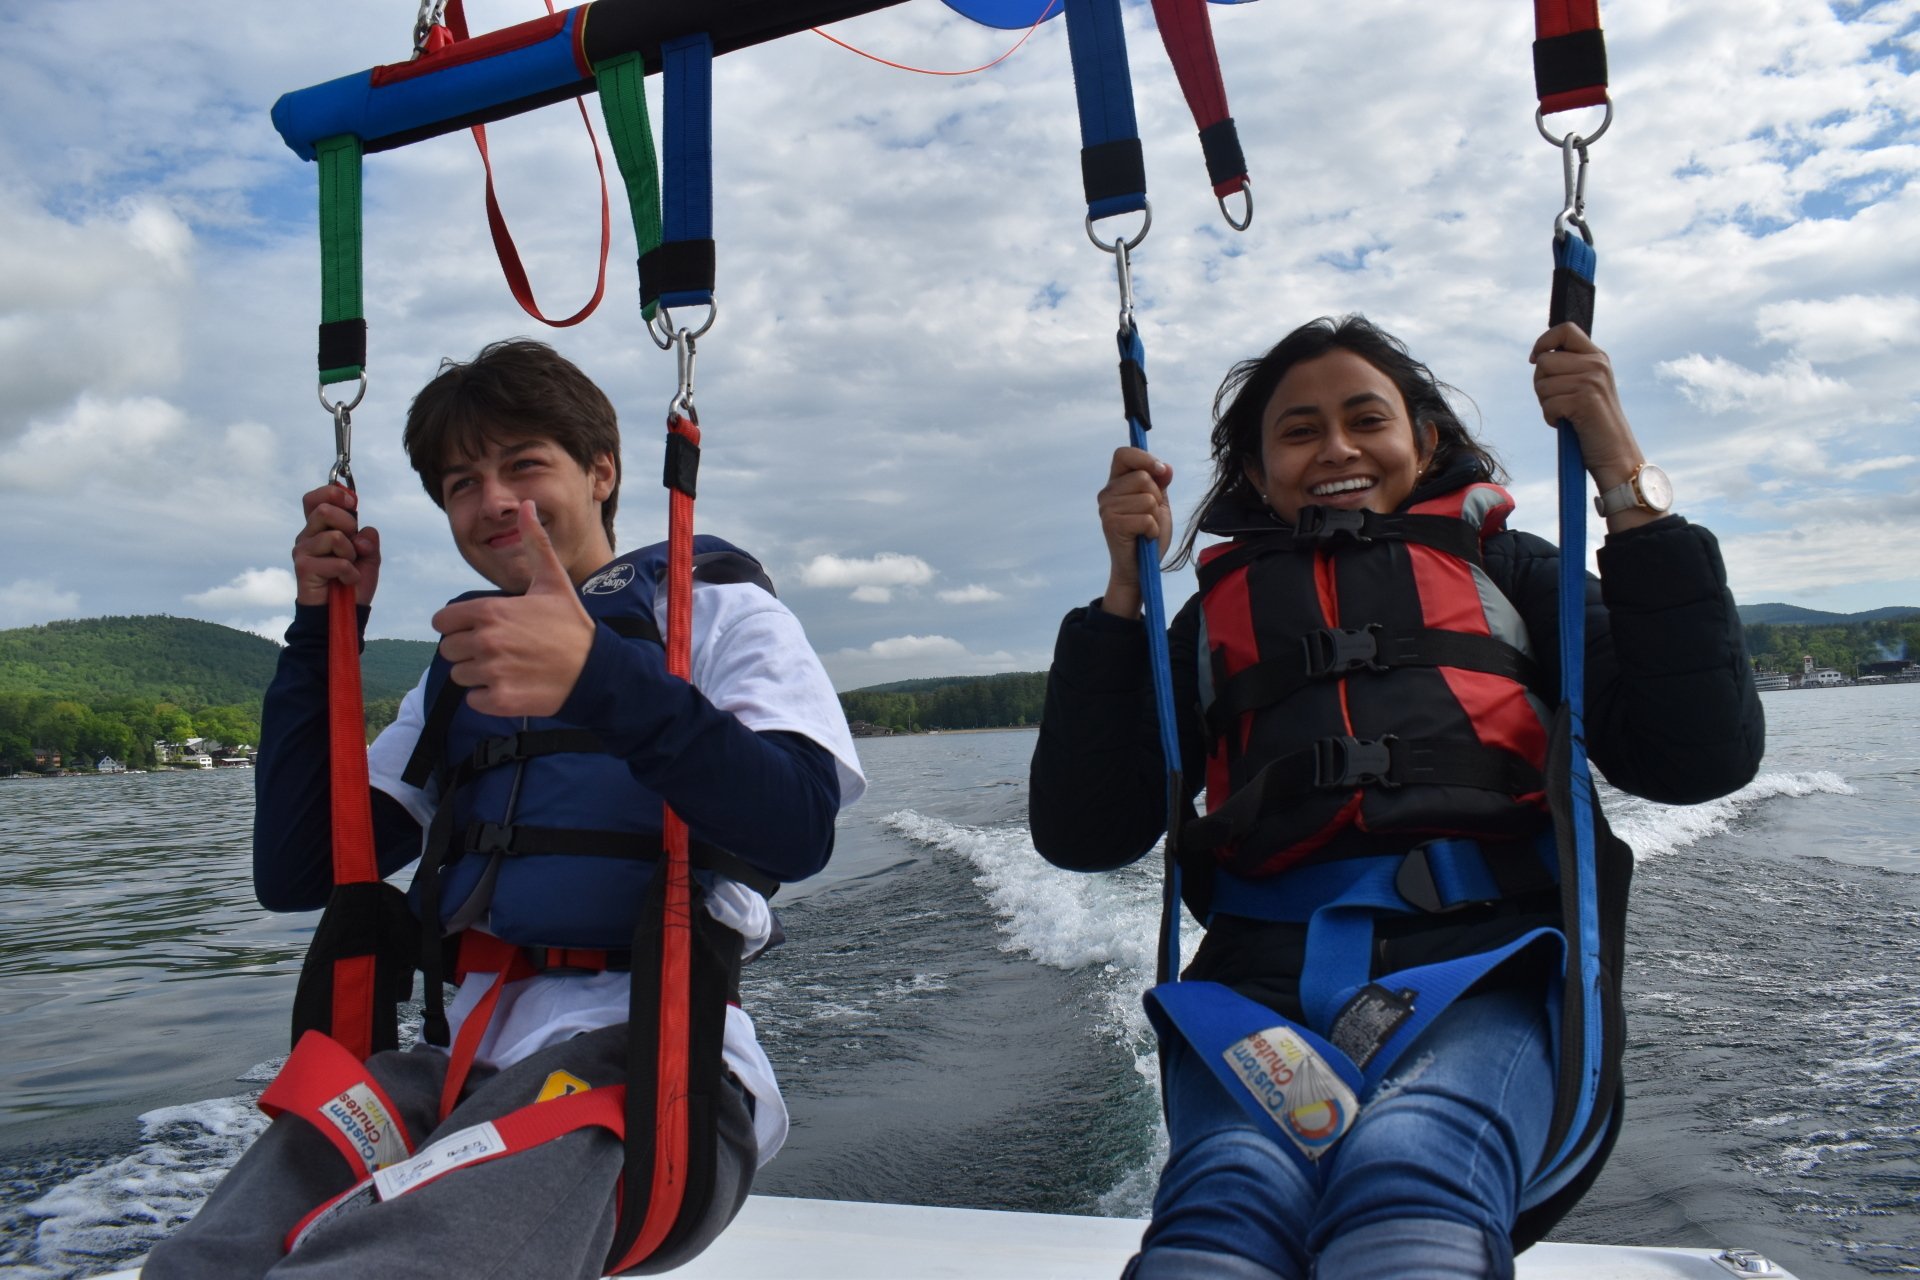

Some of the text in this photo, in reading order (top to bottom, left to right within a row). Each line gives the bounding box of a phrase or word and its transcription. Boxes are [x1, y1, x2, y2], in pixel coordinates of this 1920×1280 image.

[600, 578, 627, 588] Shops
[1232, 1044, 1285, 1112] Custom
[1248, 1033, 1294, 1086] Chutes
[330, 1103, 375, 1160] Custom
[340, 1092, 380, 1143] Chutes
